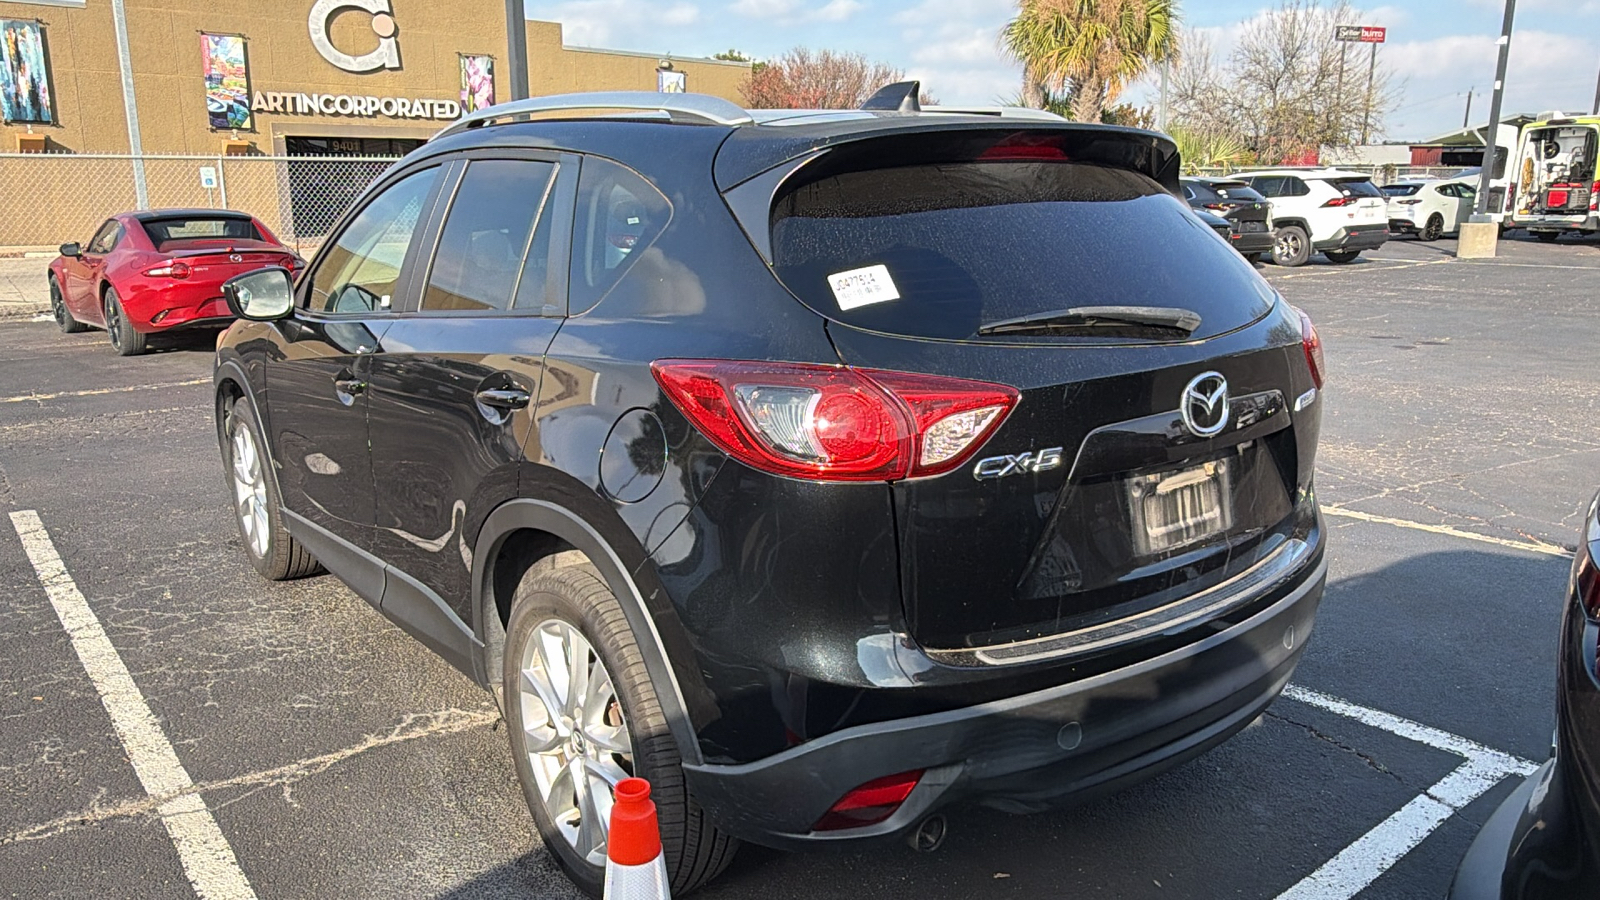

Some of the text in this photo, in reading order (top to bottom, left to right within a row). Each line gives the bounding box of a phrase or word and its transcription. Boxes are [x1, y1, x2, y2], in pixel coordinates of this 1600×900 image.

[251, 90, 460, 119] ARTINCORPORATED
[332, 140, 360, 151] 9401
[973, 446, 1063, 481] CX-5
